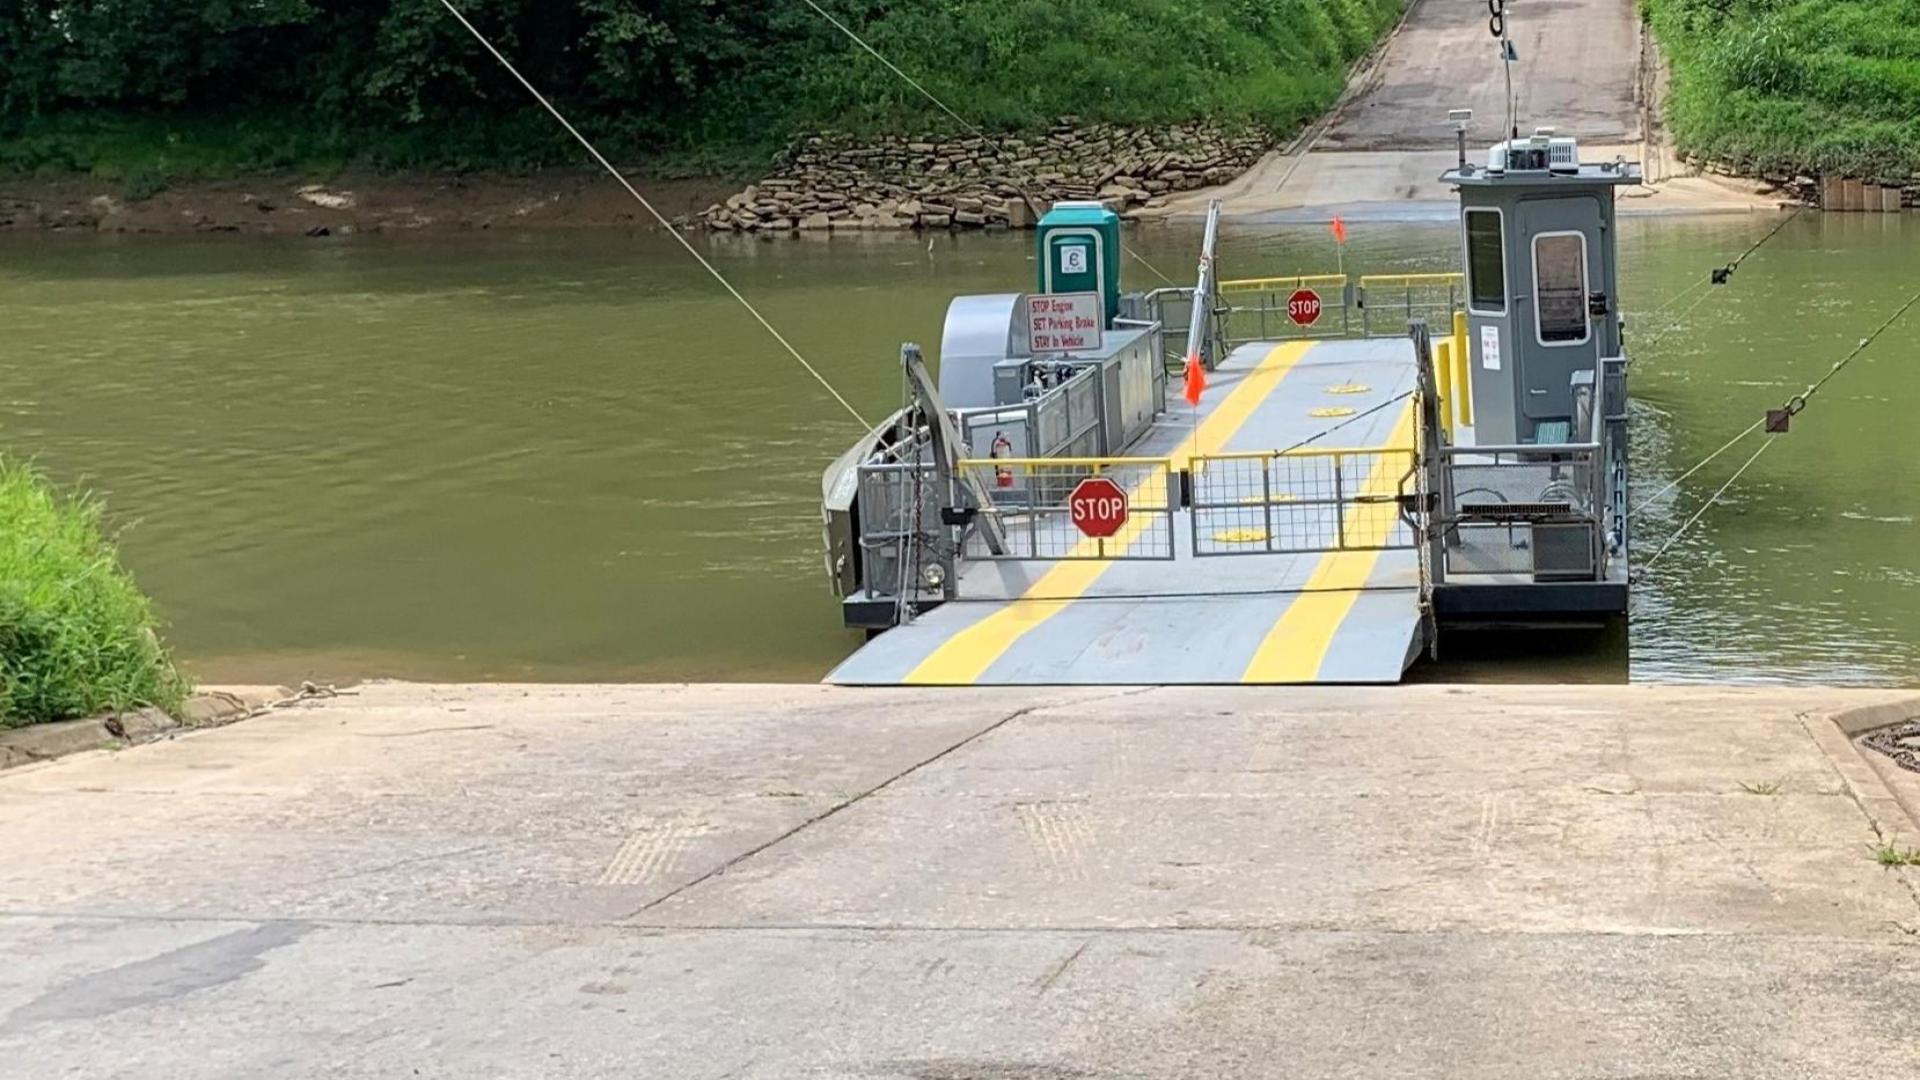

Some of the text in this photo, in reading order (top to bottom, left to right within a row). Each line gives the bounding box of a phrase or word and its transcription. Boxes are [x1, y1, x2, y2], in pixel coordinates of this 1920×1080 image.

[1032, 299, 1073, 313] STOP Engine
[1289, 300, 1319, 315] STOP
[1033, 316, 1095, 331] SET Parking Brake
[1034, 335, 1050, 348] STAY
[1061, 334, 1084, 346] Vehicle
[1074, 497, 1123, 520] STOP
